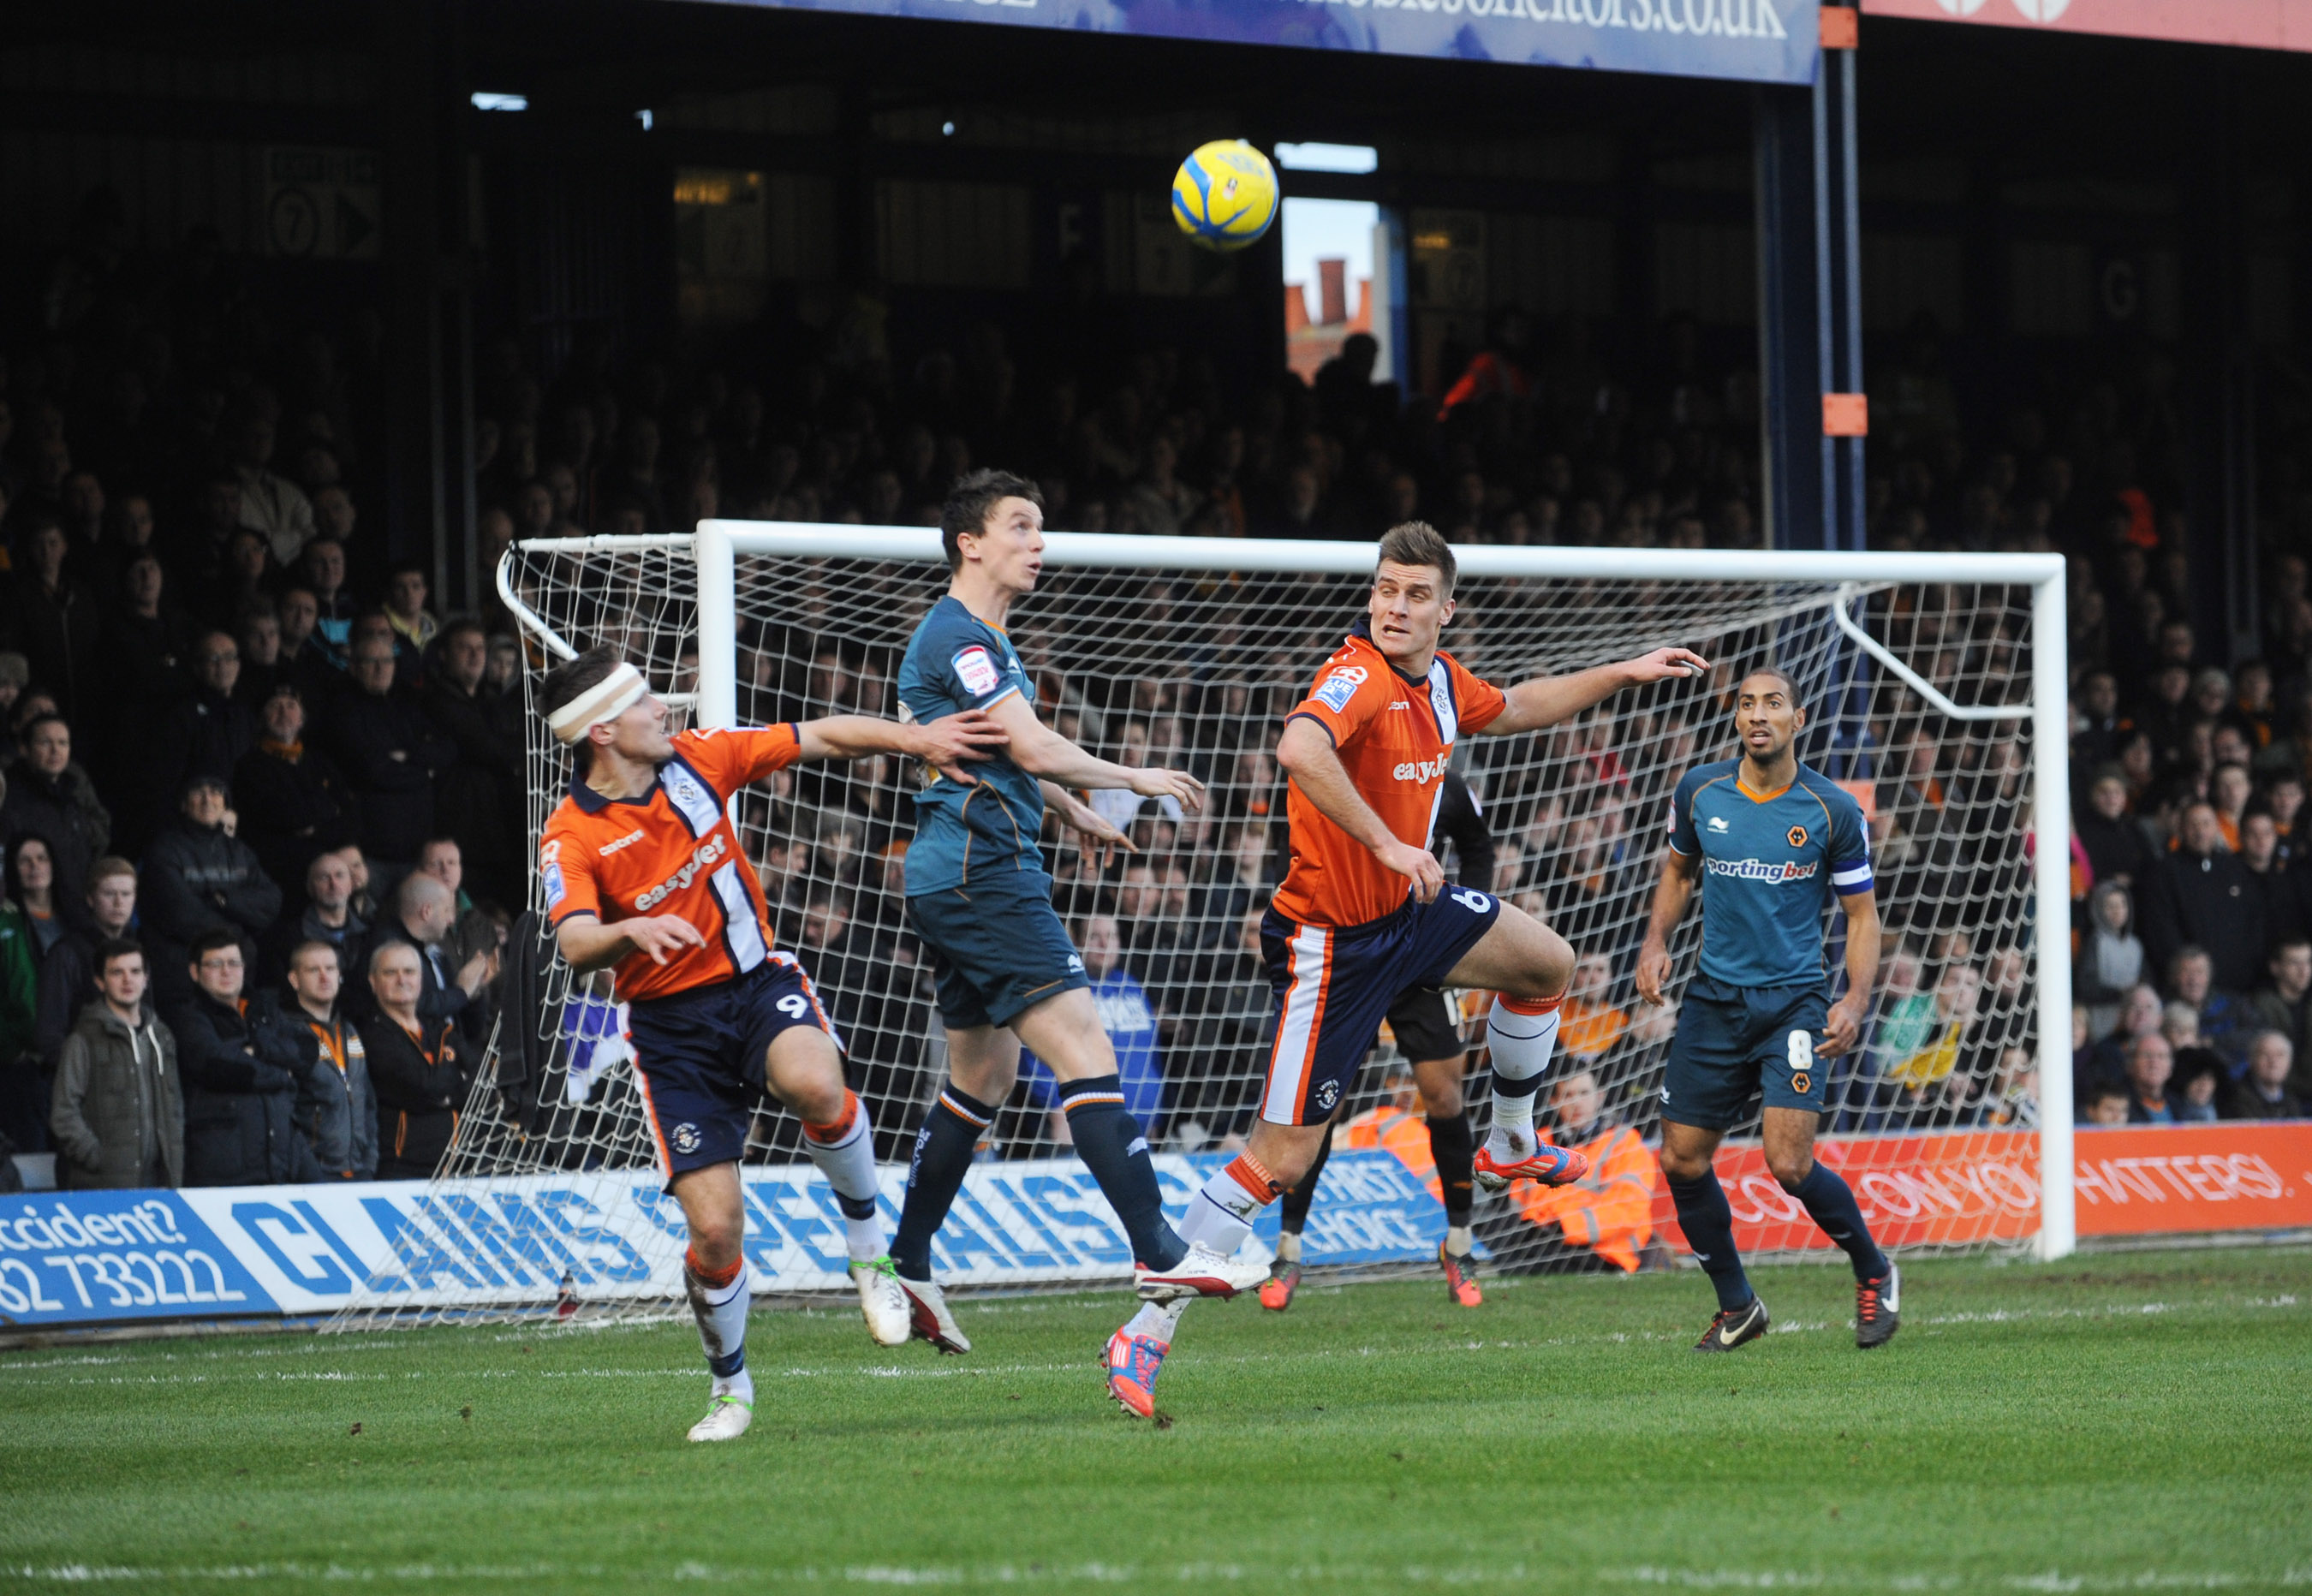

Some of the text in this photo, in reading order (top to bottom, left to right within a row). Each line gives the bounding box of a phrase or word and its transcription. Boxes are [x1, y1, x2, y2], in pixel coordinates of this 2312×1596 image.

[2102, 259, 2137, 320] G
[1393, 753, 1448, 784] eayJe
[635, 833, 726, 912] easyJet
[1451, 889, 1492, 914] 6
[775, 993, 808, 1020] 9
[1787, 1029, 1813, 1070] 8
[0, 1200, 187, 1252] ccident?
[230, 1190, 652, 1295] CLAIMS
[44, 1249, 247, 1308] 733222
